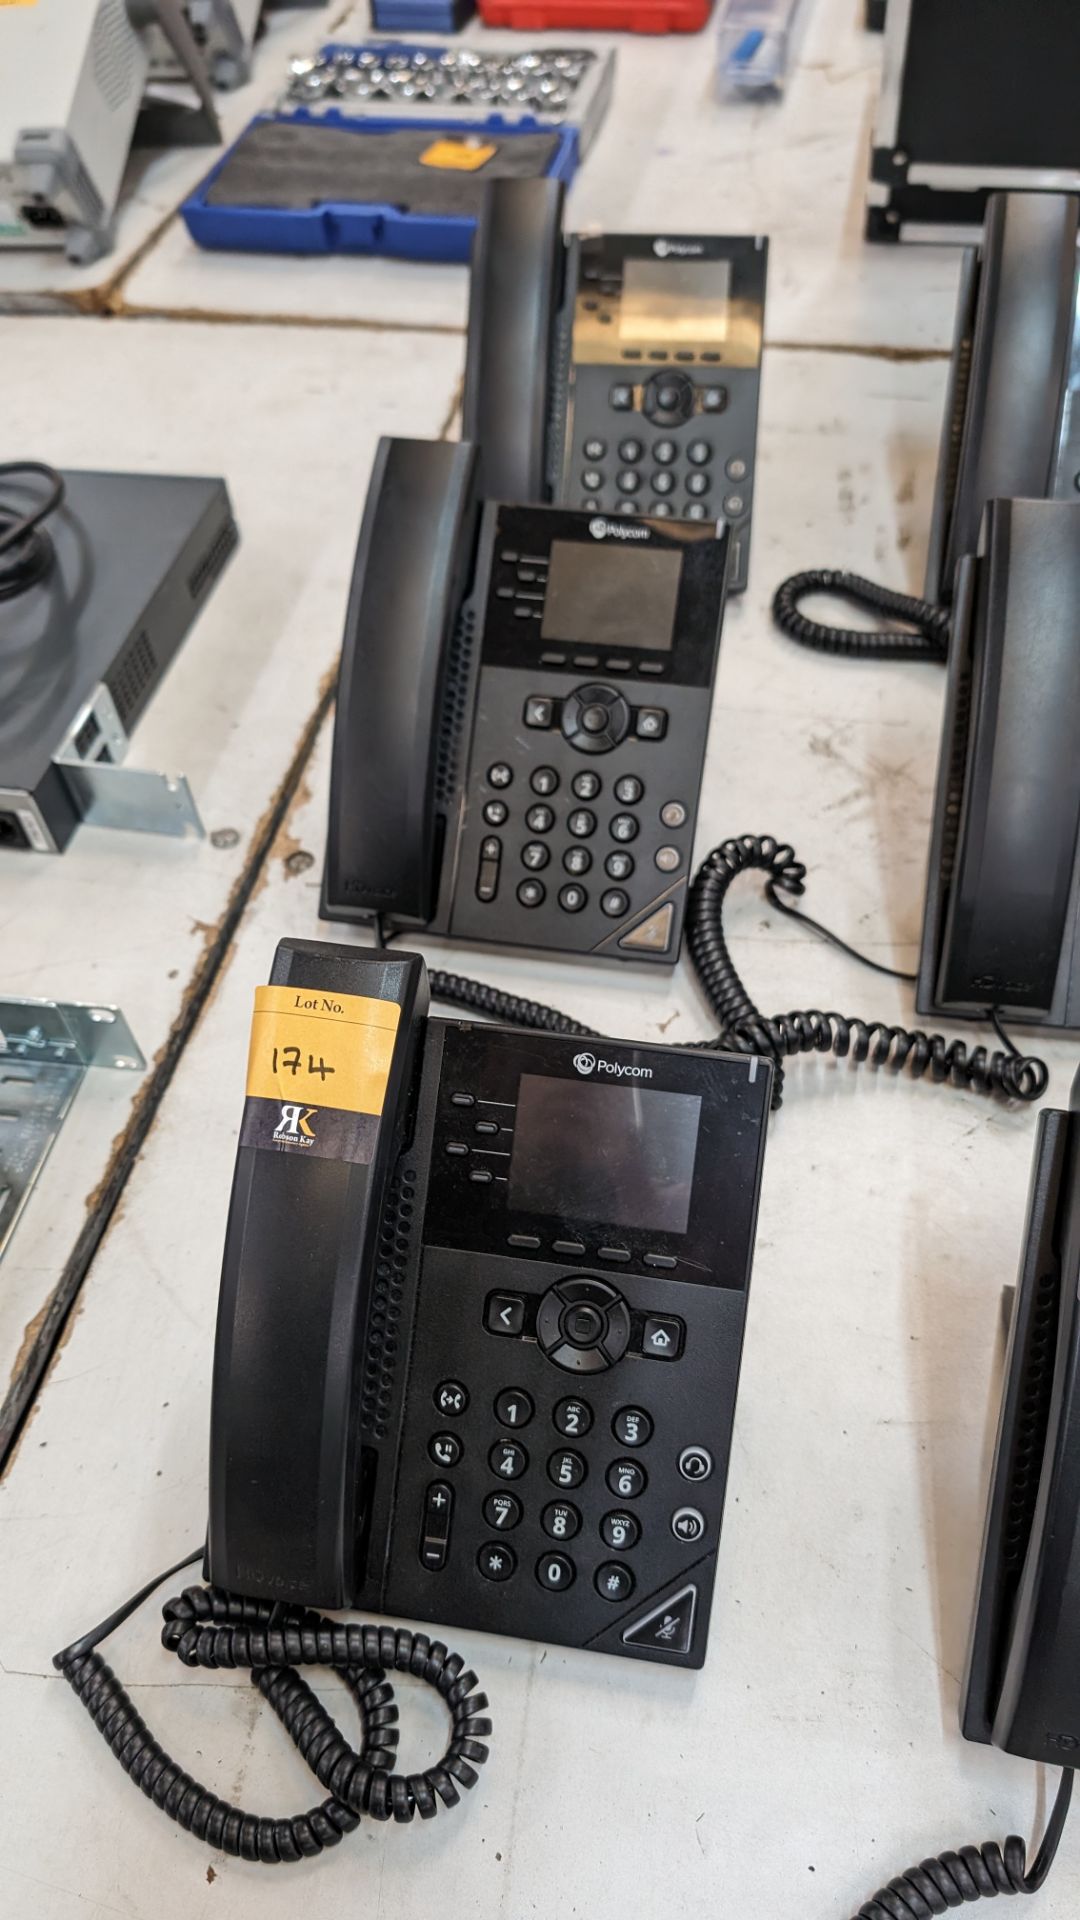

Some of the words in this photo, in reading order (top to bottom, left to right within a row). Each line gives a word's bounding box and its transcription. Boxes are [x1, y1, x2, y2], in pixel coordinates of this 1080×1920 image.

[607, 522, 650, 540] Polycom
[540, 777, 548, 792] 1
[530, 852, 540, 867] 7
[567, 890, 578, 905] 0
[294, 995, 318, 1010] Lot
[322, 999, 344, 1014] No.
[272, 1047, 335, 1081] 174
[597, 1060, 653, 1078] Polycom
[273, 1131, 298, 1142] Robson
[300, 1135, 315, 1147] Kay
[507, 1404, 517, 1423] 1
[566, 1405, 581, 1414] ABC
[565, 1414, 579, 1433] 2
[624, 1423, 638, 1441] 3
[500, 1456, 514, 1475] 4
[559, 1464, 572, 1482] 5
[618, 1467, 636, 1476] MNO
[618, 1475, 632, 1493] 6
[493, 1499, 512, 1508] PQRS
[554, 1508, 568, 1517] TUV
[495, 1507, 509, 1526] 7
[552, 1516, 567, 1535] 8
[610, 1518, 630, 1528] WXYZ
[612, 1526, 626, 1544] 9
[548, 1563, 561, 1582] 0
